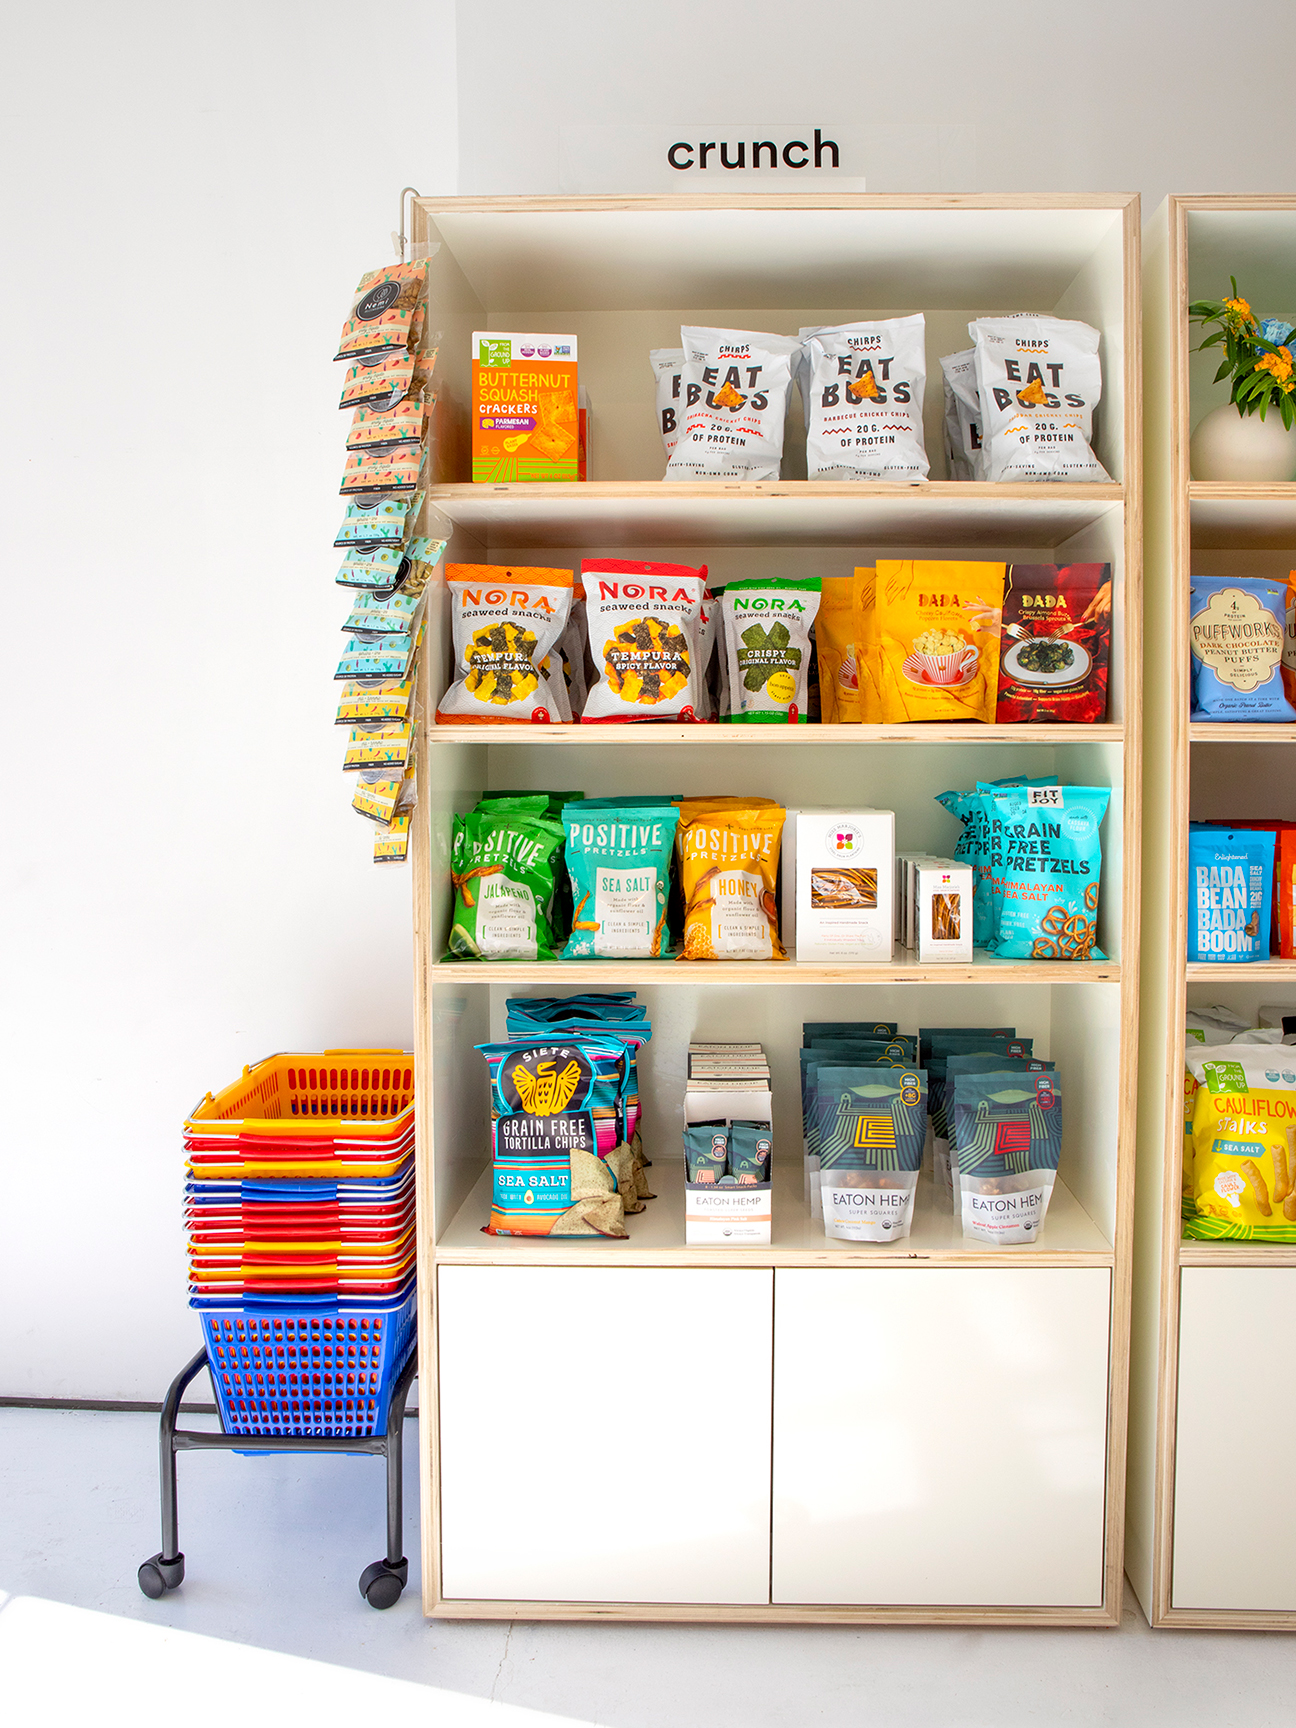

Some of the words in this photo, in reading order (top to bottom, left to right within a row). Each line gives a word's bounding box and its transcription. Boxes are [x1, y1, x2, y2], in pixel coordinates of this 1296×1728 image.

[667, 128, 839, 170] crunch
[365, 298, 389, 310] Nemi
[847, 335, 882, 346] CHIRPS
[1015, 338, 1049, 348] CHIRPS
[719, 344, 750, 353] CHIRPS
[838, 354, 895, 381] EAT
[1004, 359, 1064, 388] EAT
[479, 372, 570, 388] BUTTERNUT
[702, 365, 763, 389] EAT
[479, 388, 538, 402] SQUASH
[743, 416, 761, 425] CHIPS
[824, 413, 857, 422] BARBECUE
[891, 411, 910, 419] CHIPS
[710, 423, 722, 432] 20
[857, 425, 868, 433] 20
[692, 434, 704, 442] OF
[707, 434, 746, 447] PROTEIN
[840, 438, 851, 447] OF
[856, 435, 895, 446] PROTEIN
[1019, 435, 1030, 444] OF
[1034, 434, 1074, 443] PROTEIN
[599, 581, 695, 604] NORA
[462, 589, 556, 614] NORA
[734, 598, 806, 612] NORA
[919, 594, 960, 607] DADA
[1022, 594, 1067, 608] DADA
[600, 602, 649, 613] seaweed
[653, 603, 692, 615] snacks
[462, 608, 508, 618] seaweed
[512, 608, 551, 623] snacks
[735, 612, 770, 620] seaweed
[772, 612, 801, 621] snacks
[1193, 621, 1281, 641] PUFFWORKS
[1225, 640, 1279, 649] CHOCOLATE
[1241, 647, 1278, 655] BUTTER
[611, 651, 682, 661] TEMPURA
[747, 650, 787, 658] CRISPY
[1224, 655, 1259, 663] PUFFS
[616, 662, 641, 670] SPICY
[643, 662, 678, 670] FLAVOR
[770, 658, 796, 666] FLAVOR
[1033, 790, 1058, 799] FIT
[570, 823, 662, 848] POSITIVE
[1004, 822, 1061, 839] GRAIN
[685, 829, 774, 854] POSITIVE
[1008, 840, 1051, 855] FREE
[584, 846, 647, 857] PRETZELS
[690, 852, 761, 862] PRETZELS
[1215, 852, 1249, 861] Enlightened
[1006, 856, 1091, 875] PRETZELS
[1196, 866, 1246, 888] BADA
[602, 877, 621, 893] SEA
[625, 876, 650, 892] SALT
[718, 879, 758, 898] HONEY
[1003, 882, 1064, 893] HIMALAYAN
[1003, 890, 1020, 899] SEA
[1021, 892, 1049, 902] SALT
[1197, 887, 1247, 909] BEAN
[1198, 909, 1246, 931] BADA
[1198, 930, 1252, 952] BOOM
[522, 1046, 570, 1063] SIETE
[1219, 1074, 1244, 1082] GROUND
[503, 1119, 544, 1136] GRAIN
[551, 1119, 586, 1136] FREE
[504, 1137, 550, 1150] TORTILLA
[555, 1136, 586, 1149] CHIPS
[1224, 1144, 1239, 1152] SEA
[498, 1175, 526, 1187] SEA
[529, 1175, 569, 1187] SALT
[696, 1197, 730, 1206] EATON
[732, 1197, 762, 1206] HEMP
[833, 1193, 875, 1206] EATON
[972, 1198, 1016, 1212] EATON
[1012, 1210, 1036, 1219] SQUARES
